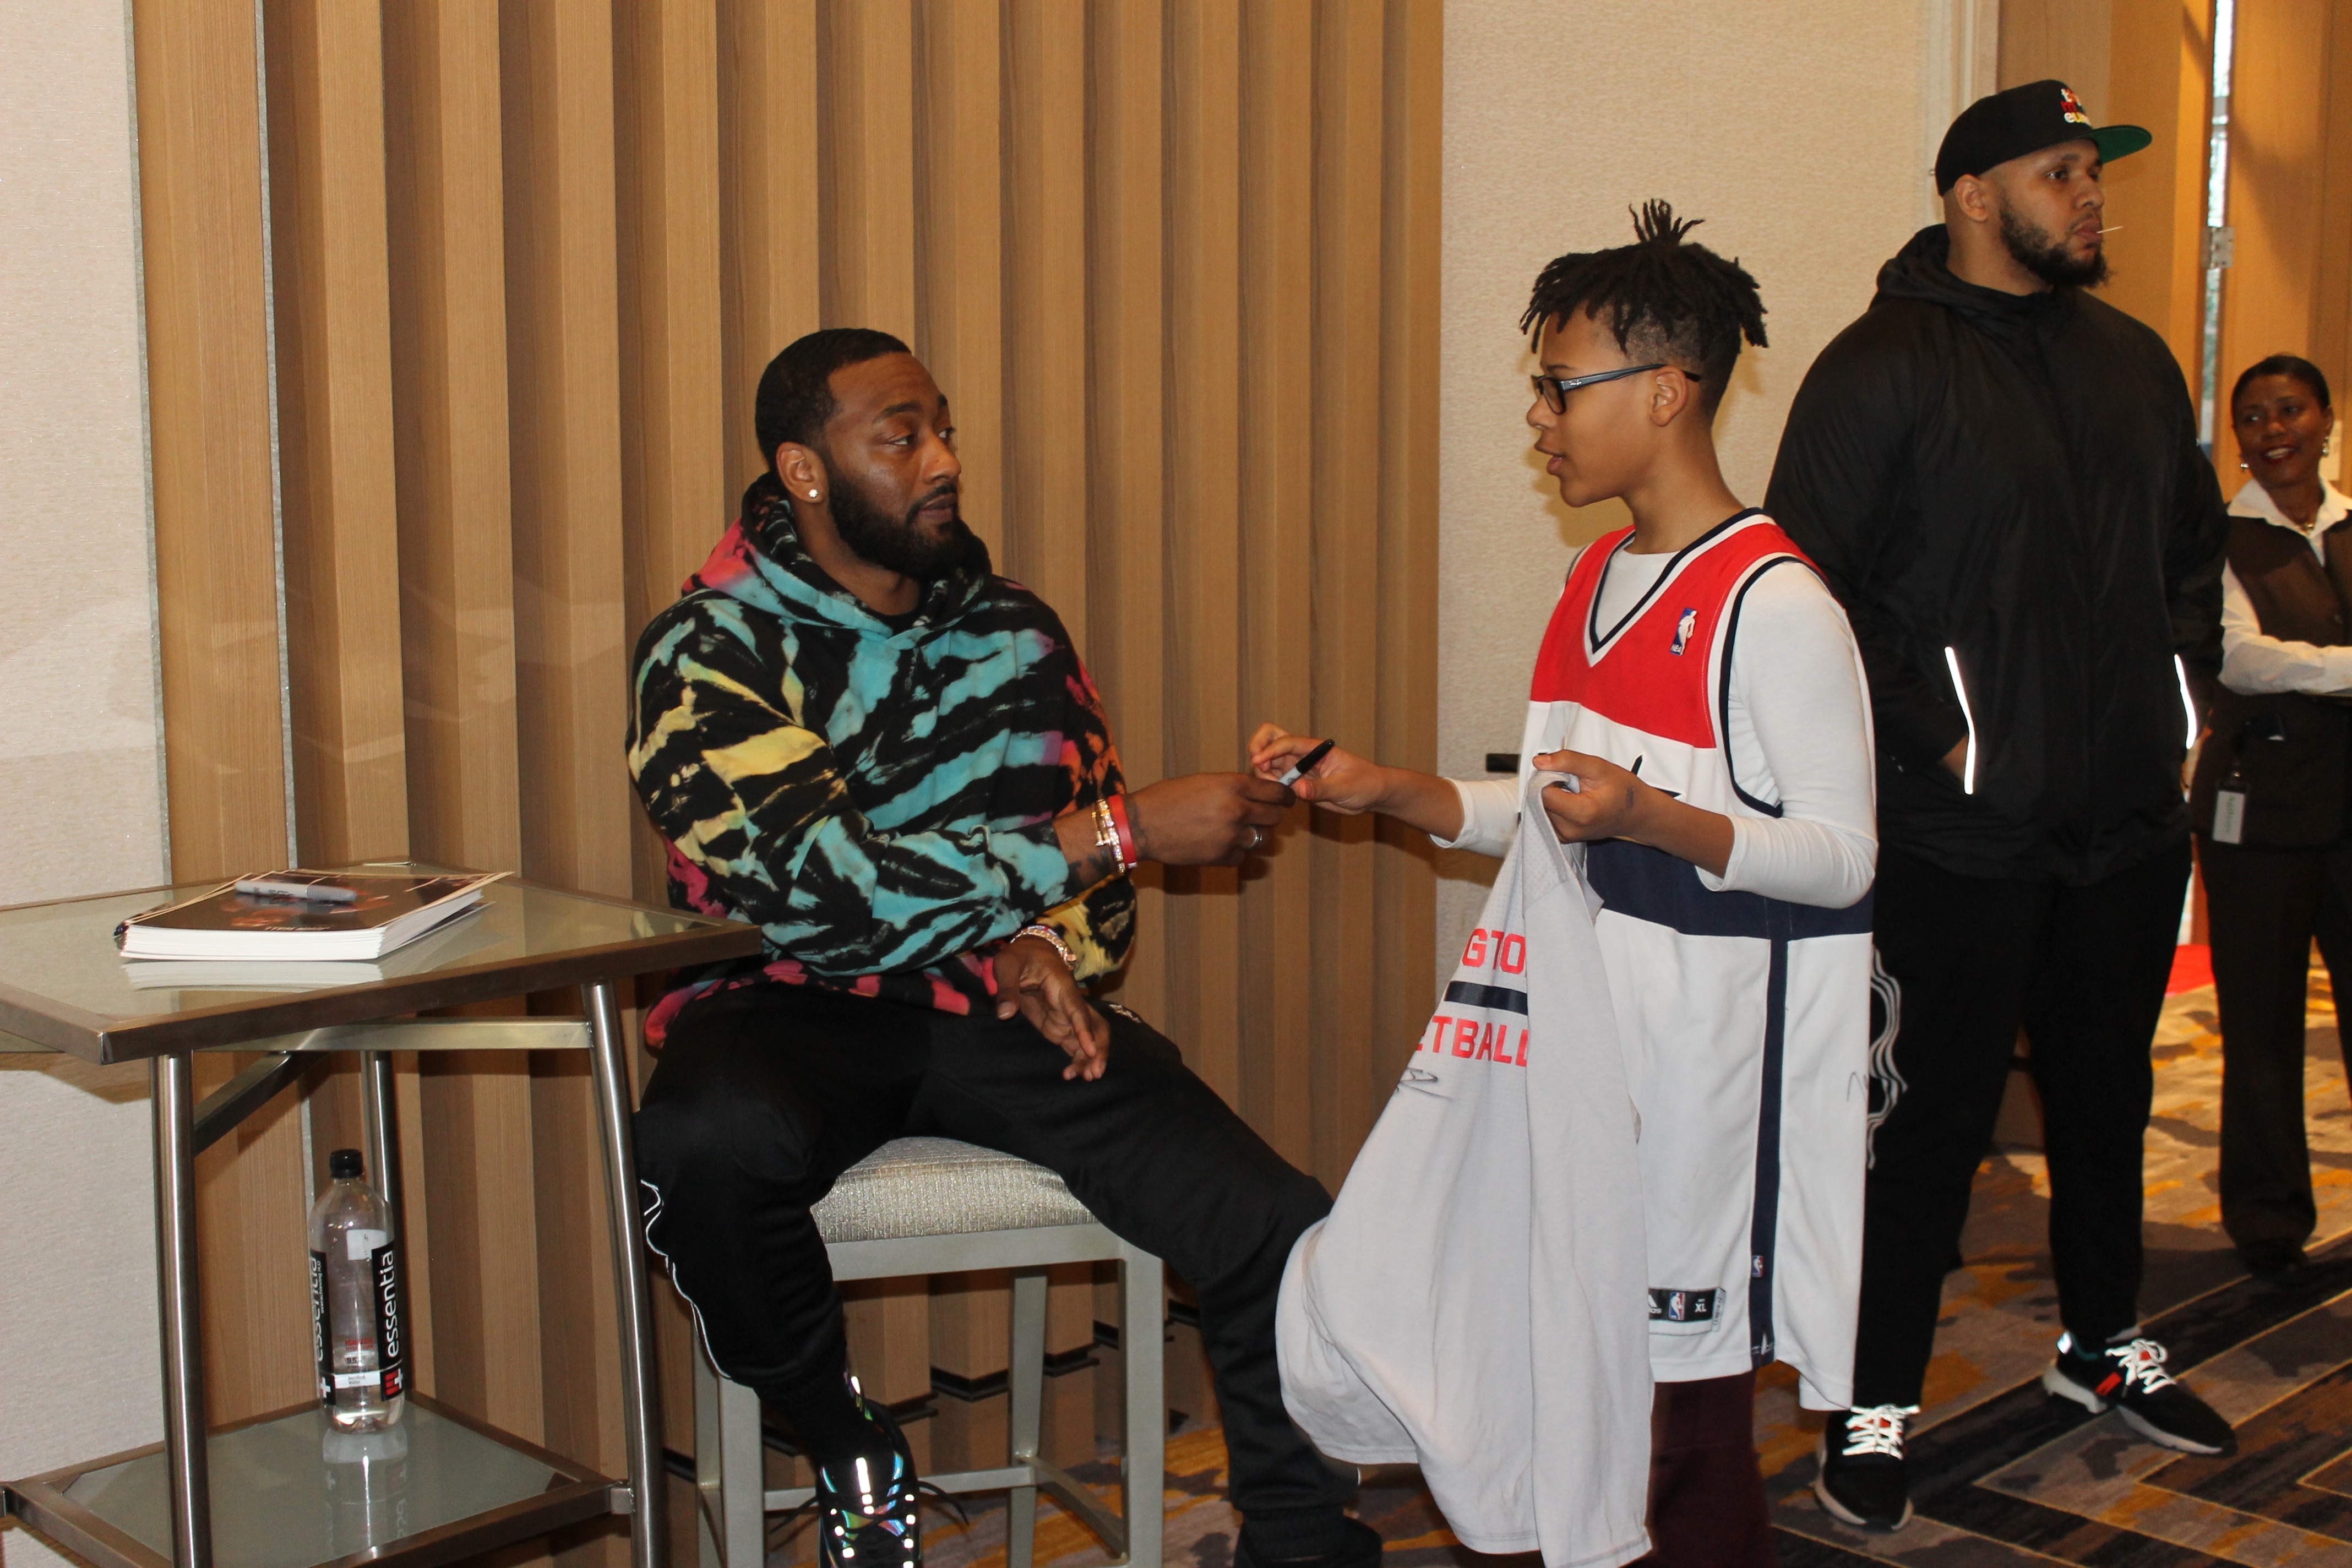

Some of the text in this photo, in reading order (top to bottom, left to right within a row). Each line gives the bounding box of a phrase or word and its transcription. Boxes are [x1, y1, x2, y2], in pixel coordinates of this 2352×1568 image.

[1462, 928, 1527, 977] GTO
[1417, 1015, 1529, 1068] TBALL
[379, 1250, 399, 1358] essentia
[1695, 1303, 1707, 1313] XL
